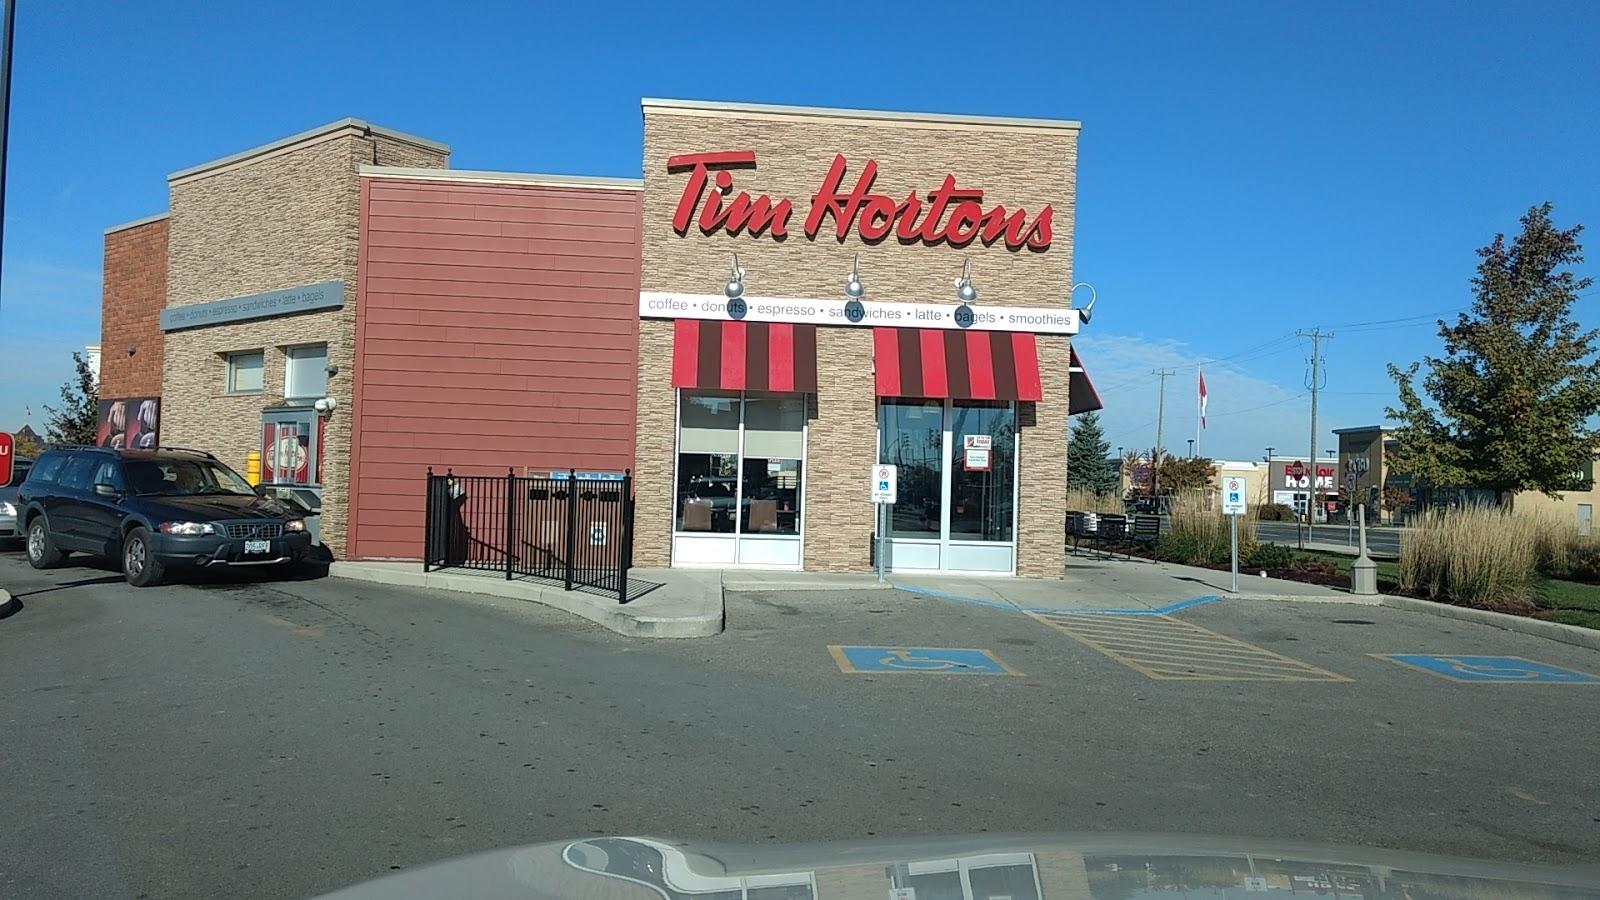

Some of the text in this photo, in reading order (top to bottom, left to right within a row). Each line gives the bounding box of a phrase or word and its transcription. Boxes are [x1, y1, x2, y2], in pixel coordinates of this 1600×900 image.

[667, 151, 1054, 251] Tim Hortons
[189, 309, 208, 320] donuts
[212, 304, 238, 318] espresso
[241, 298, 277, 312] sandwiches
[282, 295, 297, 305] latte
[302, 289, 325, 305] bagels
[648, 297, 1071, 326] coffee donuts espresso sandwiches latte bagels smoothies
